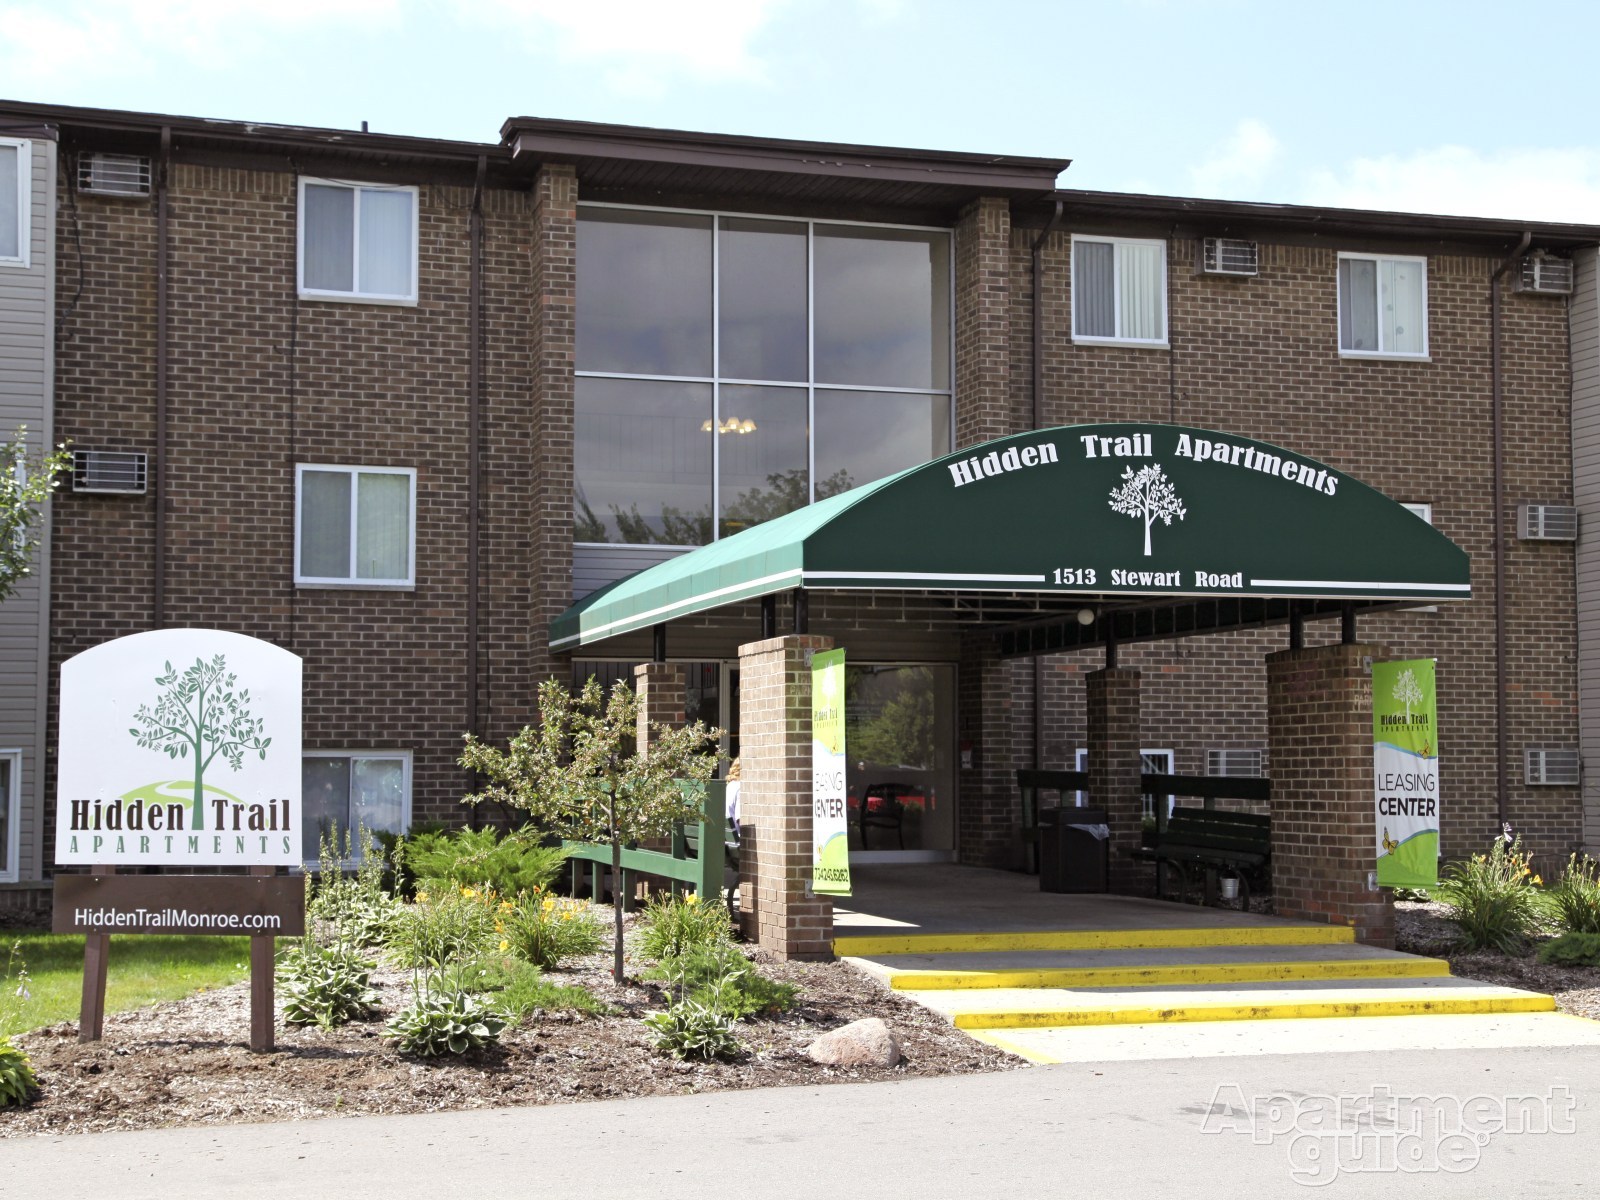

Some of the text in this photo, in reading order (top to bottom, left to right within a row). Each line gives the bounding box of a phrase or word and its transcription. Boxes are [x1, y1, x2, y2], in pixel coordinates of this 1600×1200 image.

[948, 433, 1339, 496] Hidden Trail Apartments
[1052, 568, 1243, 589] 1513 Stewart Road
[1380, 713, 1429, 725] Hidden Trail
[1378, 773, 1435, 792] LEASING
[70, 799, 291, 831] Hidden Trail
[1379, 797, 1436, 817] CENTER
[69, 835, 291, 854] APARTMENTS
[74, 908, 281, 928] HiddenTrailMonroe.com
